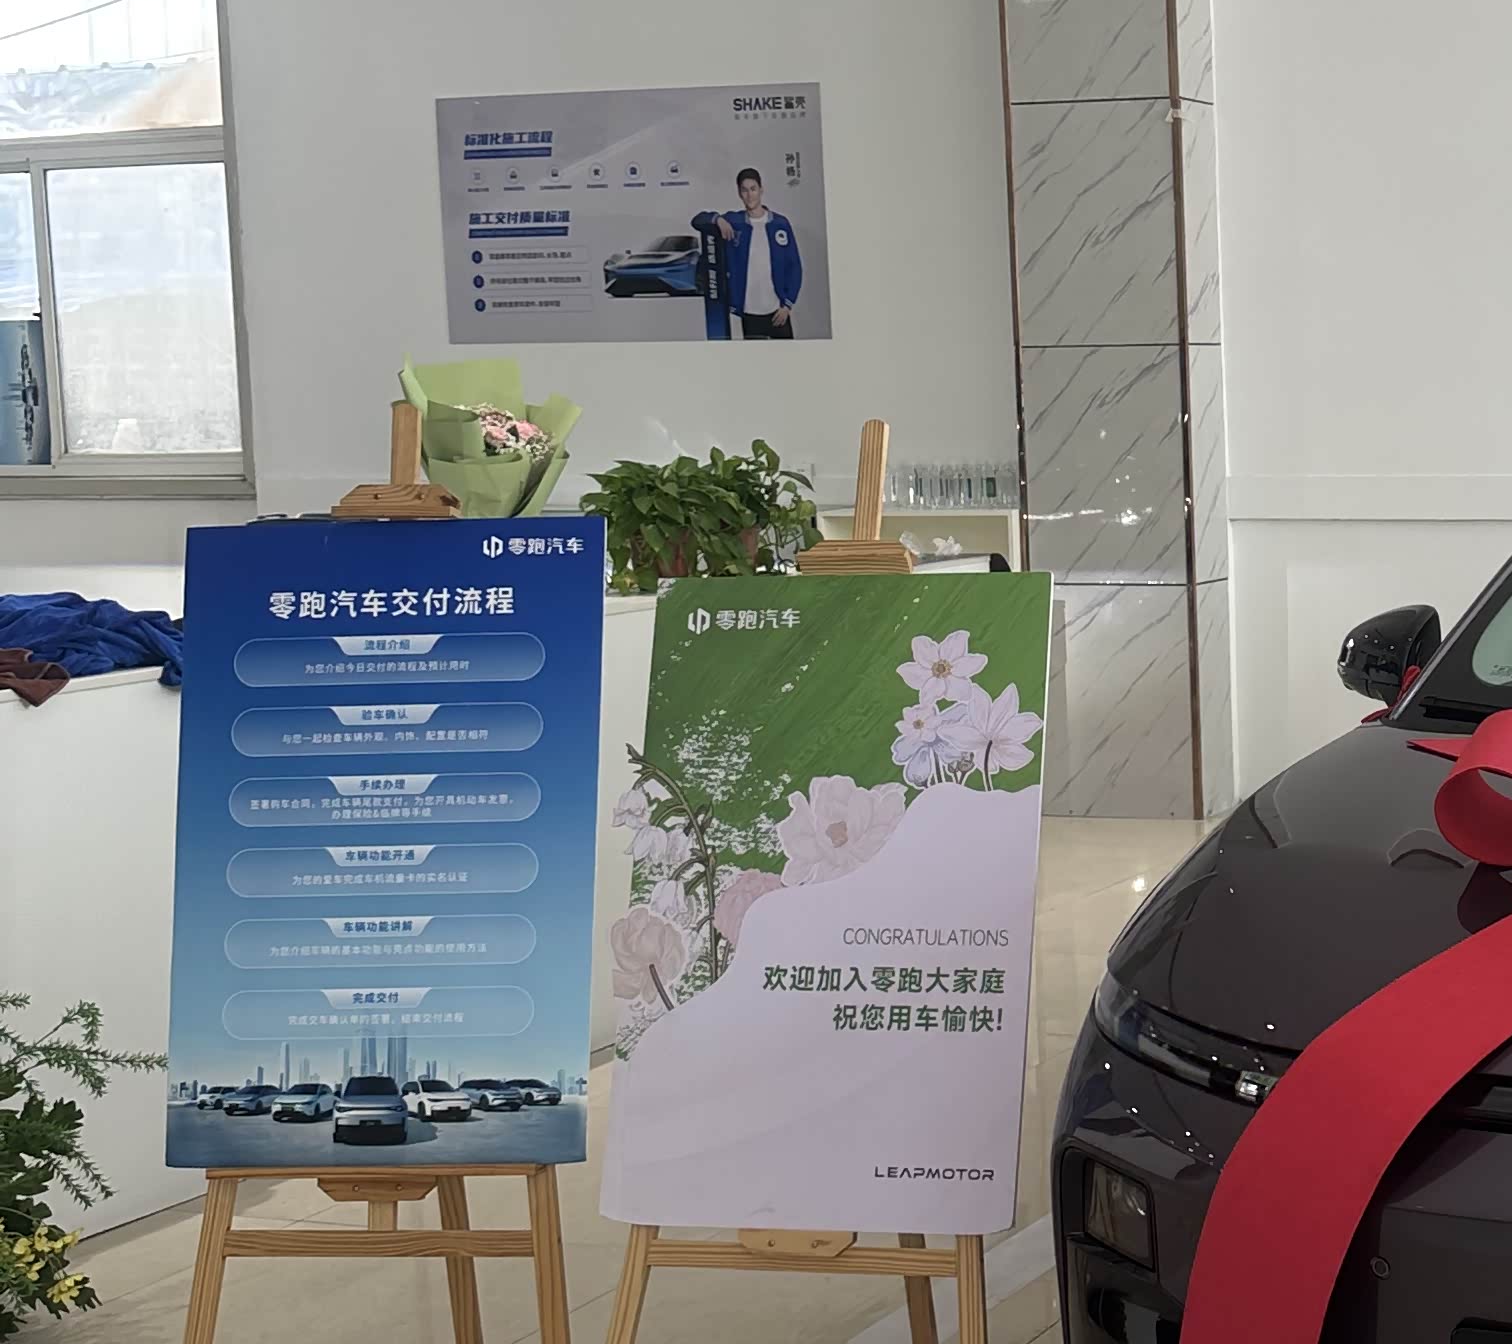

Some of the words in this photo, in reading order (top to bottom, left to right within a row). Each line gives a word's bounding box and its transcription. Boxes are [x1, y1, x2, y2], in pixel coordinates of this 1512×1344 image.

[733, 96, 782, 111] SHAKE
[463, 130, 554, 147] 标准化施工流程
[468, 210, 571, 226] 施工交付质量标准
[508, 536, 585, 556] 零跑汽车
[268, 586, 516, 621] 零跑汽车交付流程
[715, 607, 801, 630] 零跑汽车
[363, 638, 411, 652] 流程介绍
[360, 708, 409, 722] 验车确认
[358, 778, 407, 792] 手续办理
[344, 849, 416, 863] 车辆功能开通
[342, 920, 414, 934] 车辆功能讲解
[843, 928, 1009, 947] CONGRATULATIONS
[762, 964, 1007, 994] 欢迎加入零跑大家庭
[352, 991, 400, 1005] 完成交付
[832, 1003, 1004, 1033] 祝您用车愉快!
[874, 1165, 996, 1182] LEAPMOTOR
